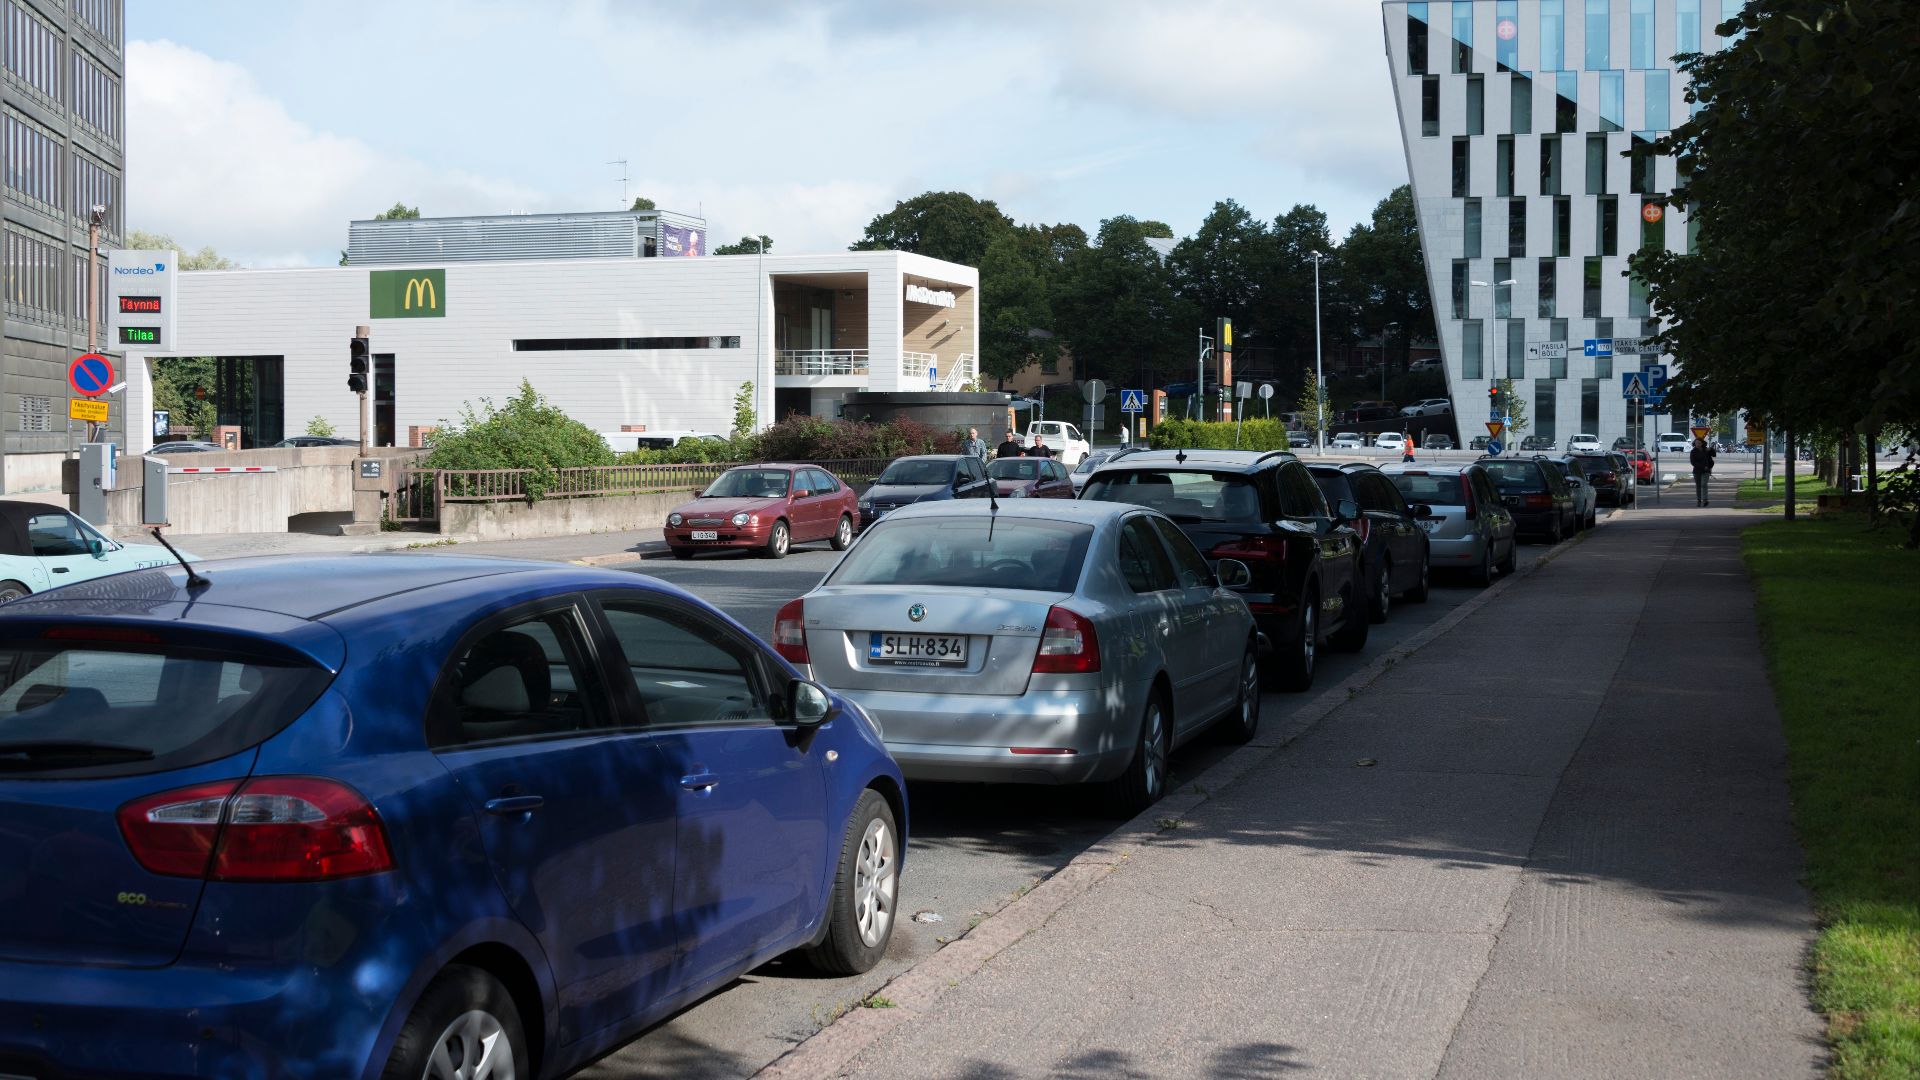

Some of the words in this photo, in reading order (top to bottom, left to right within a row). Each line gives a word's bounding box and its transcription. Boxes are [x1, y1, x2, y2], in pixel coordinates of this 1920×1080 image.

[114, 266, 154, 275] Nordea
[127, 329, 154, 341] Tilaa
[1648, 366, 1664, 387] P
[885, 636, 961, 657] SLH-834
